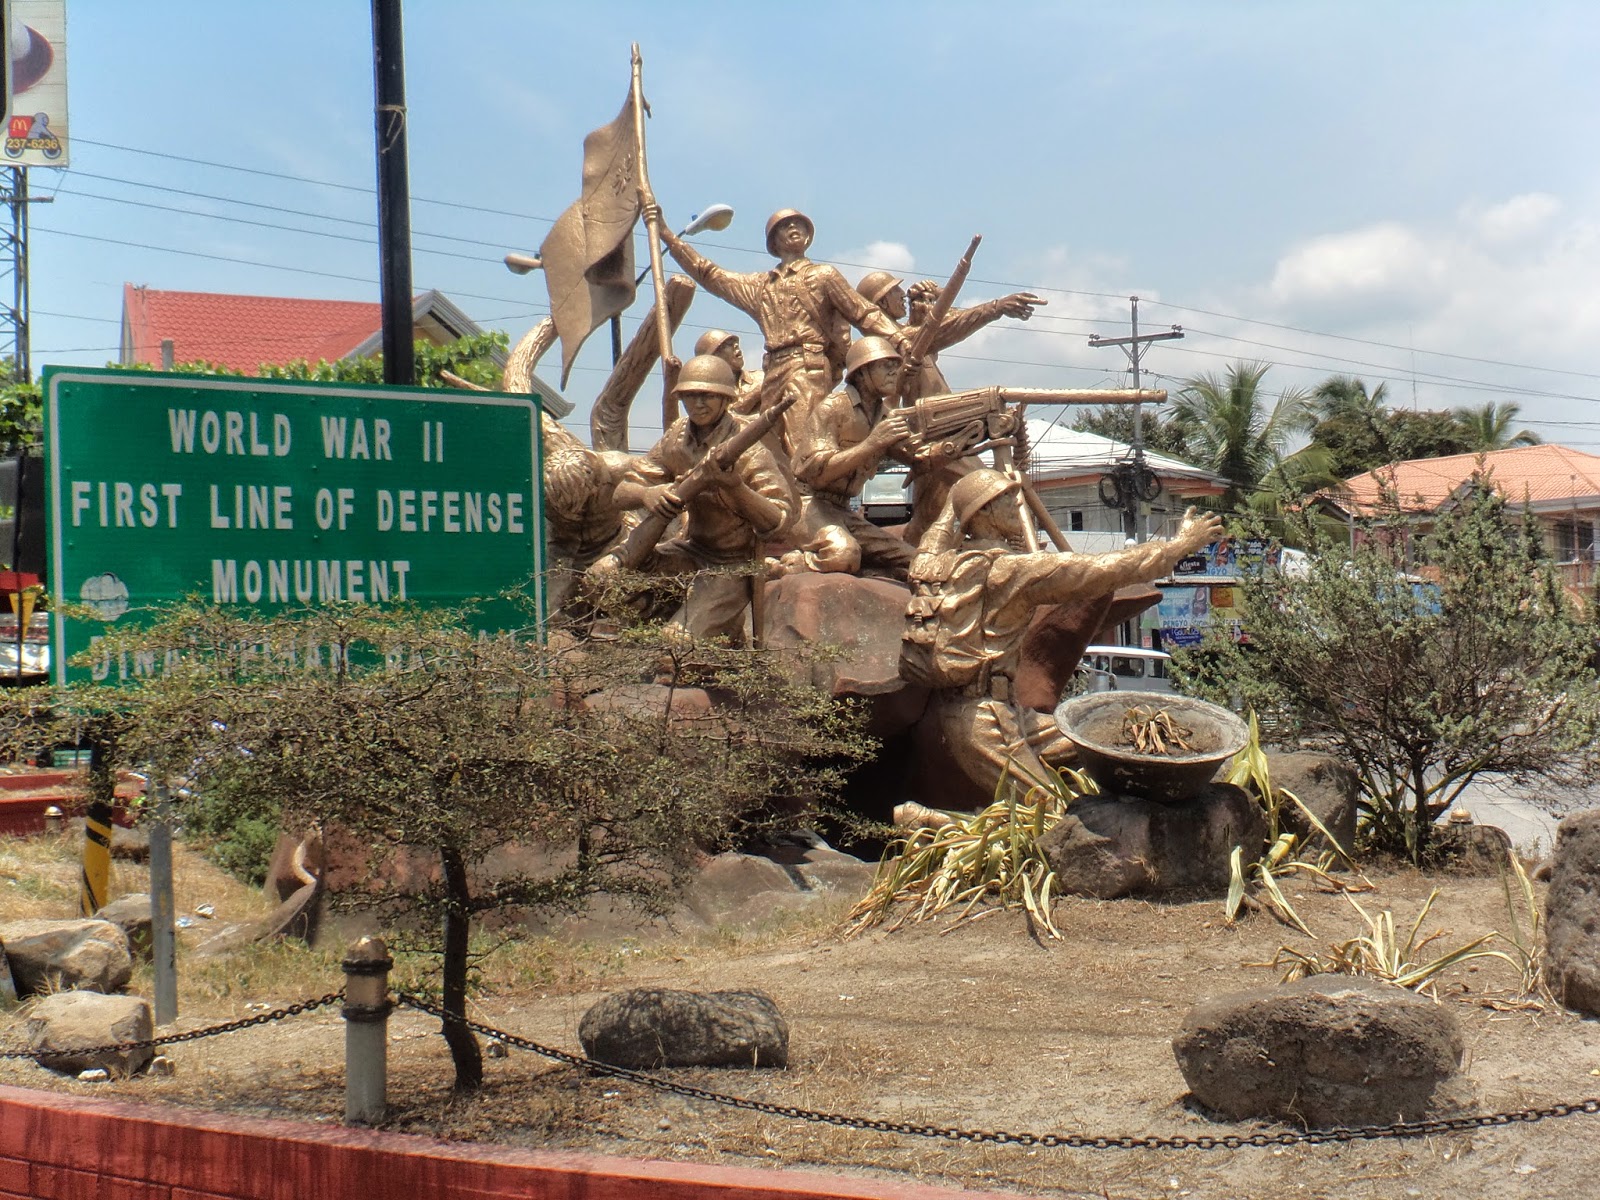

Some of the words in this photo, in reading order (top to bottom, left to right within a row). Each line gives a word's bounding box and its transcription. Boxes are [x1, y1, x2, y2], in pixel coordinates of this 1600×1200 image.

[7, 138, 58, 149] 237-6236
[168, 408, 291, 457] WORLD
[321, 417, 392, 461] WAR
[423, 421, 443, 462] II
[71, 481, 182, 528] FIRST
[210, 485, 293, 530] LINE
[315, 488, 354, 531] OF
[377, 490, 524, 534] DEFENSE
[212, 559, 410, 604] MONUMENT
